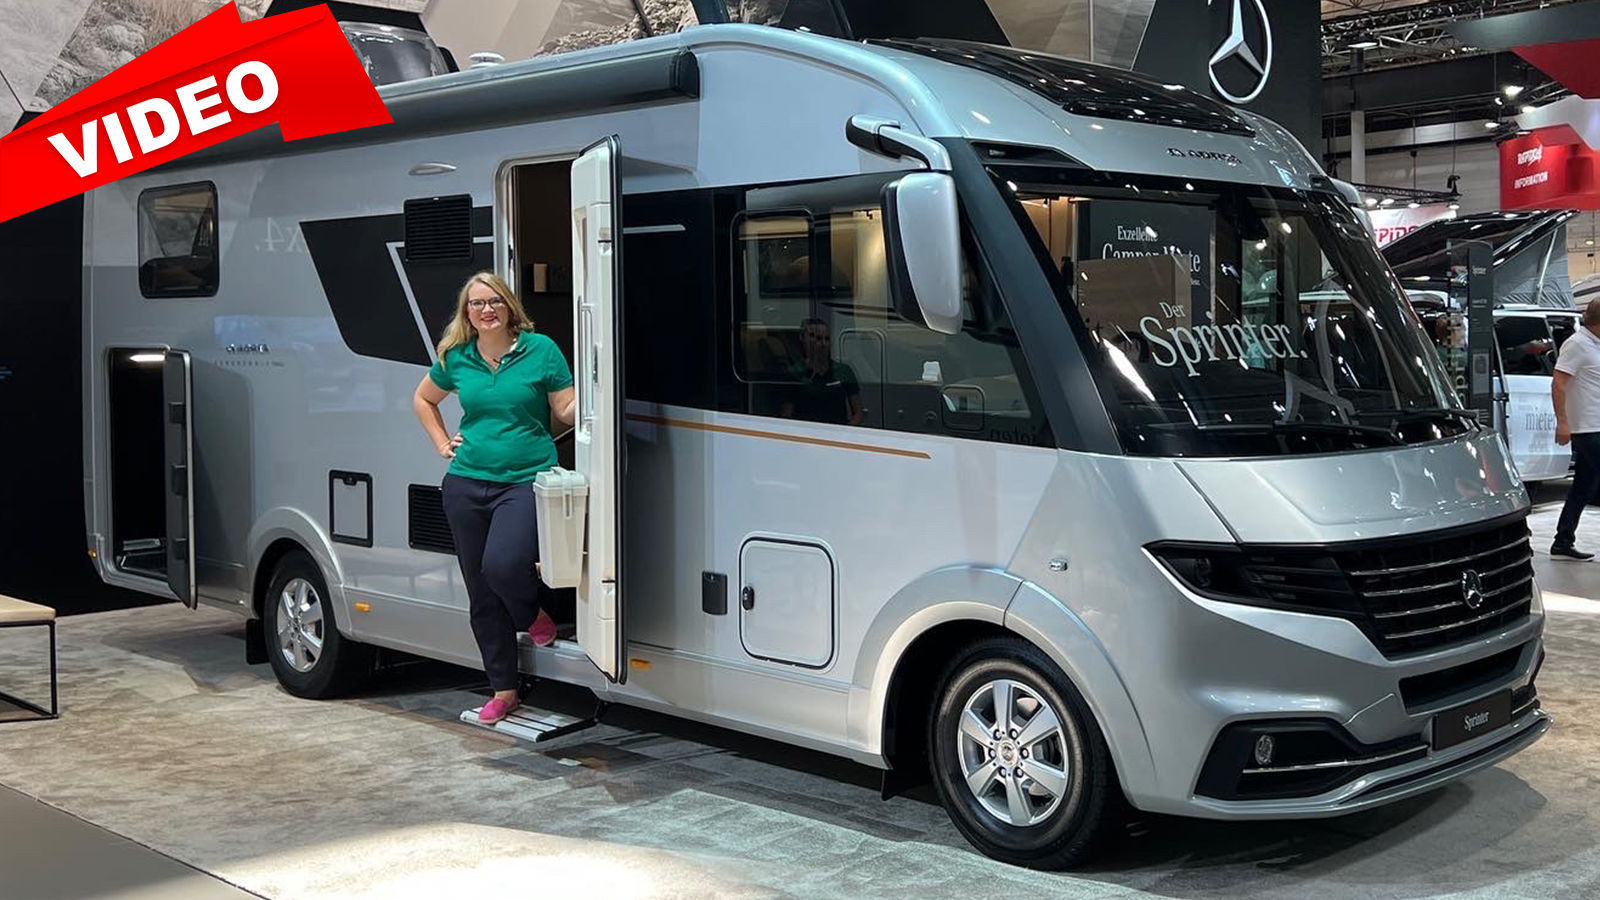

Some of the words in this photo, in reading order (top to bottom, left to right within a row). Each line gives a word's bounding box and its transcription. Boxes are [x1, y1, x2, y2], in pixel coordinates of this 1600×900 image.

[1159, 302, 1187, 319] Der
[1139, 310, 1308, 377] Sprinter.
[1525, 407, 1556, 431] miete
[1463, 711, 1490, 731] Sprinter
